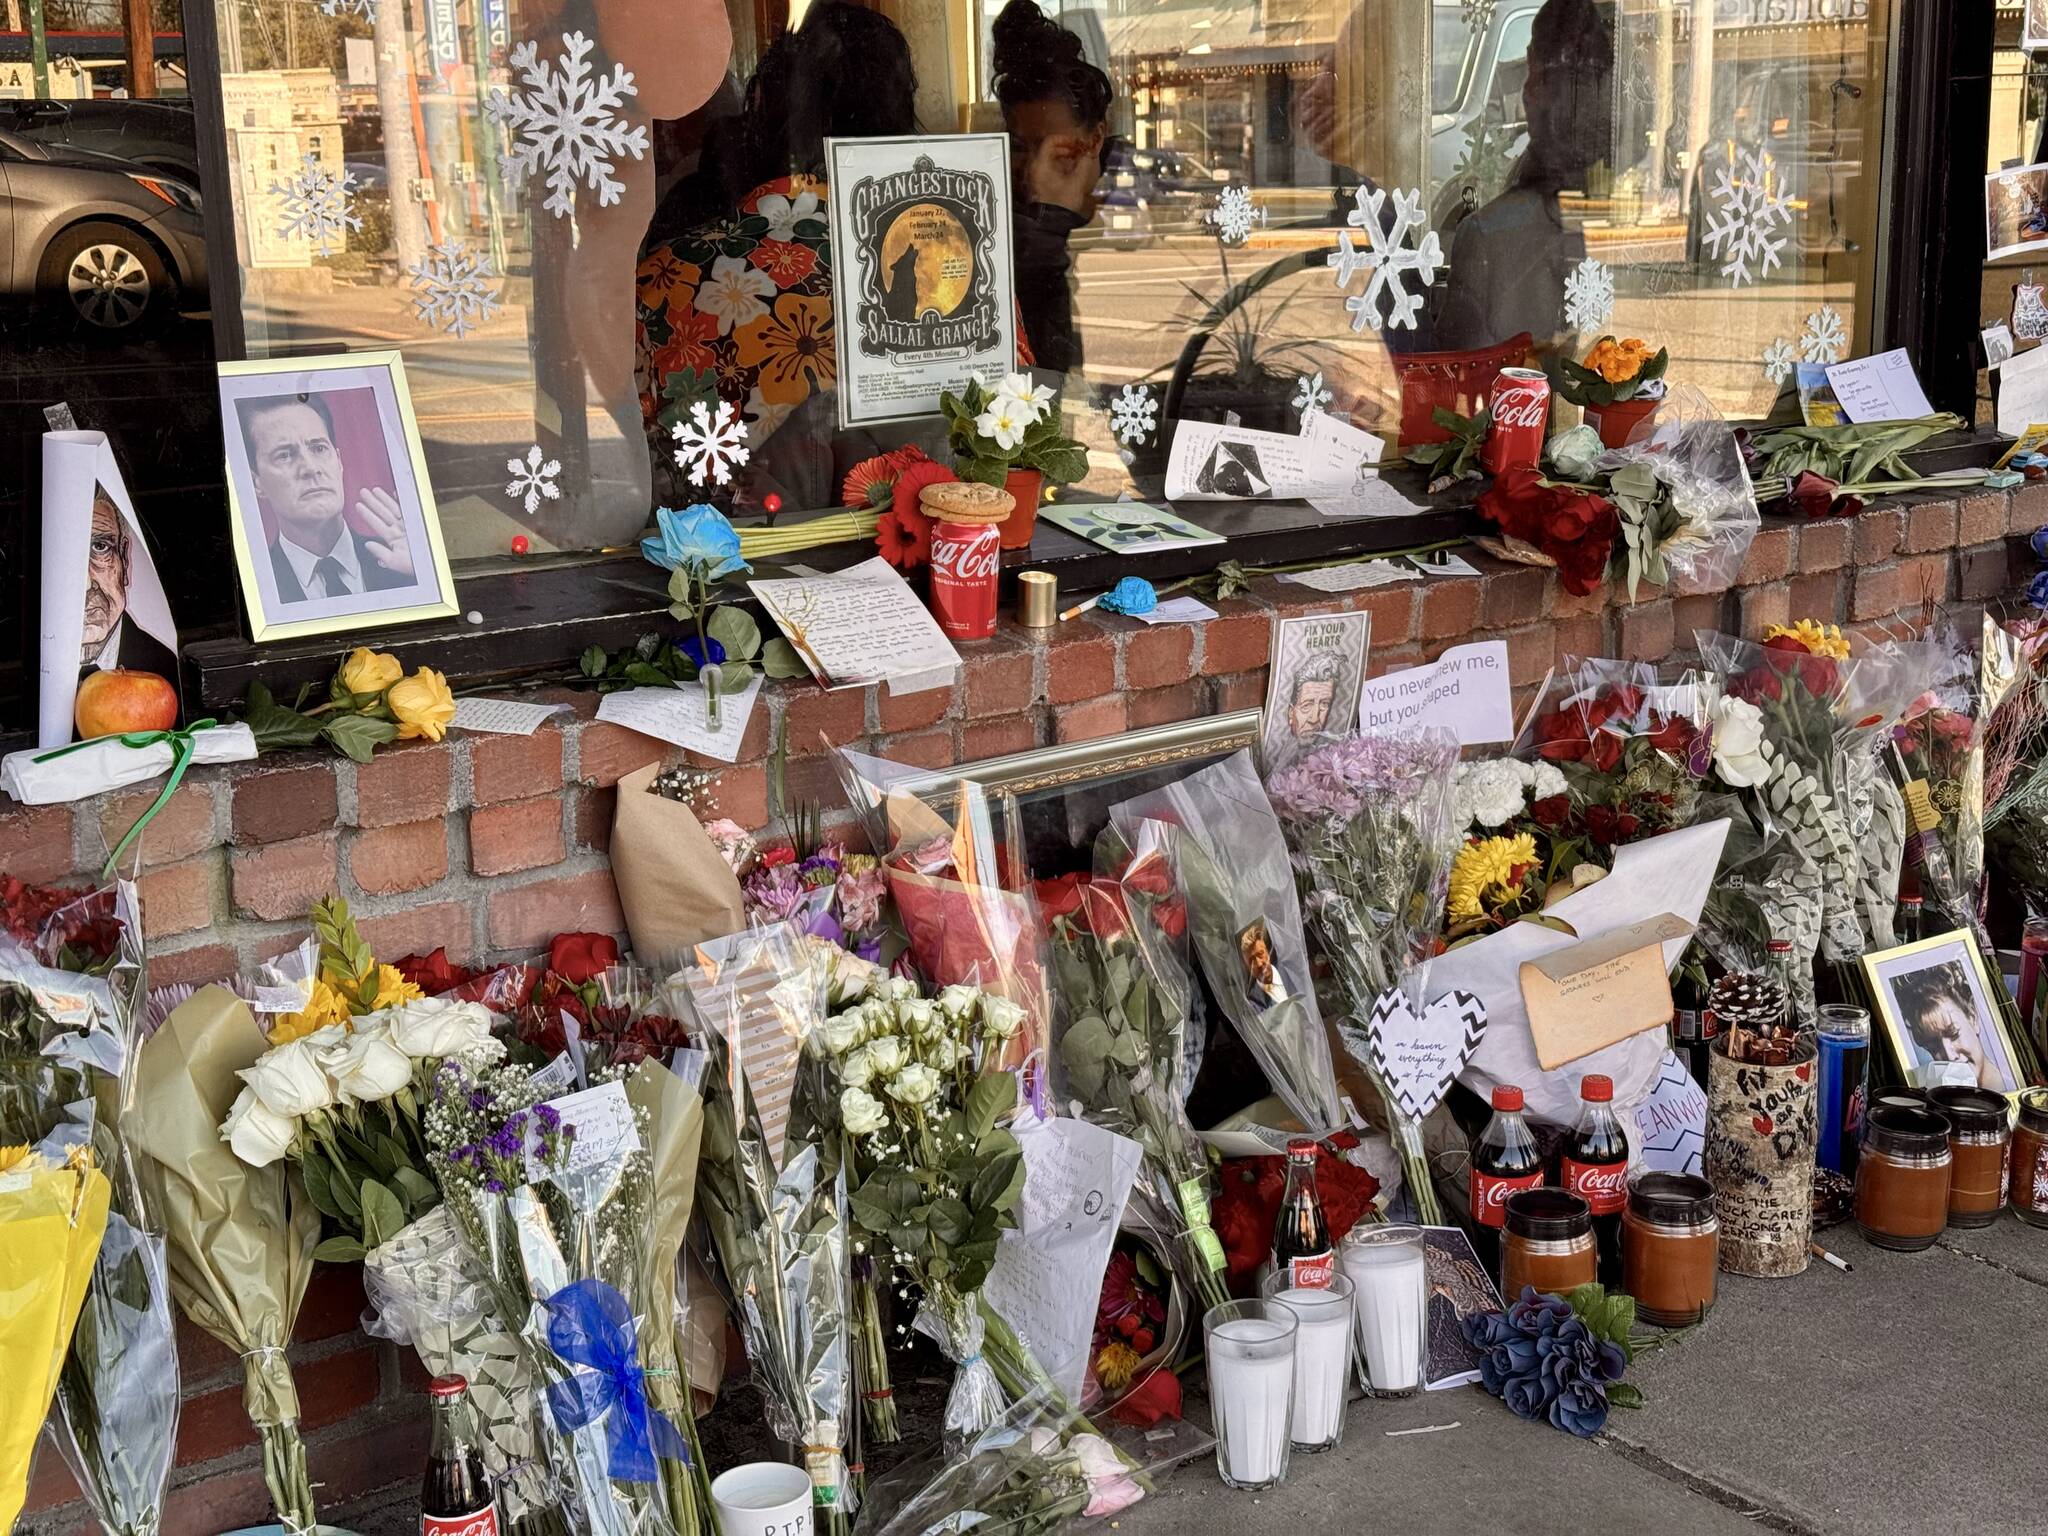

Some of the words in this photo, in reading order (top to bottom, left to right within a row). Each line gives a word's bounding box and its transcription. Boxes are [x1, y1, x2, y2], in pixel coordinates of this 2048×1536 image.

[856, 170, 992, 241] GRANGESTOCK
[909, 210, 934, 218] January
[909, 221, 938, 230] February
[914, 232, 934, 240] March
[867, 309, 926, 347] SALLAL
[932, 304, 991, 346] GRANGE
[925, 313, 937, 325] AT
[903, 353, 921, 361] Every
[922, 351, 934, 360] 4th
[934, 349, 960, 359] Monday
[1303, 624, 1319, 636] FIX
[1320, 621, 1346, 635] YOUR
[1305, 635, 1341, 649] HEARTS
[1367, 686, 1396, 703] You
[1466, 654, 1500, 670] me,
[1368, 708, 1393, 727] but
[1396, 702, 1420, 725] you
[1410, 1038, 1448, 1051] heaven
[1398, 1052, 1447, 1069] everything
[1415, 1068, 1436, 1084] fine
[1748, 1079, 1800, 1120] YOUR
[1634, 1088, 1707, 1143] EANWH
[1716, 1186, 1745, 1204] WHO
[1749, 1197, 1781, 1208] THE
[1716, 1199, 1750, 1219] FUCK
[1758, 1208, 1804, 1220] CARES
[1742, 1220, 1781, 1232] LONG
